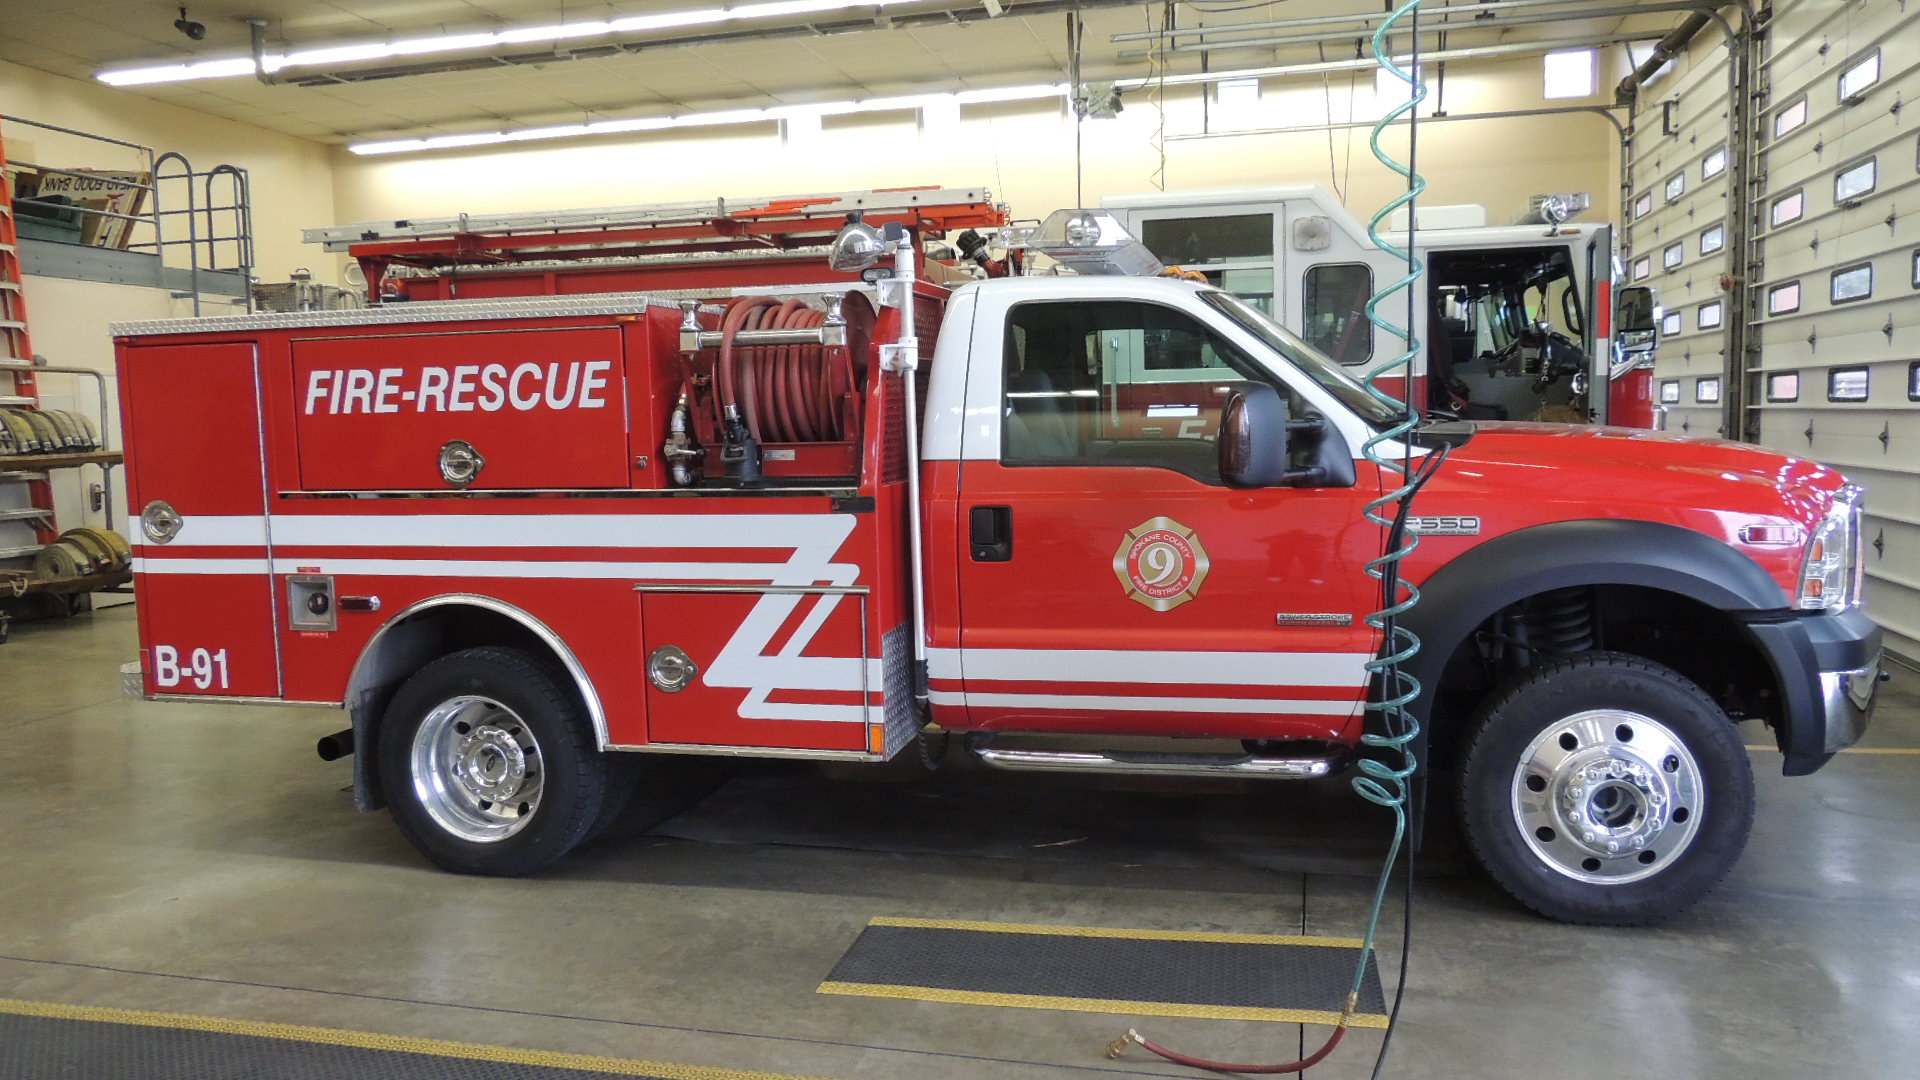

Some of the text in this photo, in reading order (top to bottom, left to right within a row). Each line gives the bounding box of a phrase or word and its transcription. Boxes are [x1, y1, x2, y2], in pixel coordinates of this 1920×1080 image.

[42, 177, 71, 192] BANK
[74, 177, 104, 191] FOOD
[305, 361, 611, 415] FIRE-RESCUE
[1129, 533, 1192, 560] SPOKANE COUNTY
[1144, 547, 1175, 585] 9
[1133, 575, 1149, 592] FIRE
[1148, 581, 1184, 597] DISTRICT
[155, 645, 229, 690] B-91
